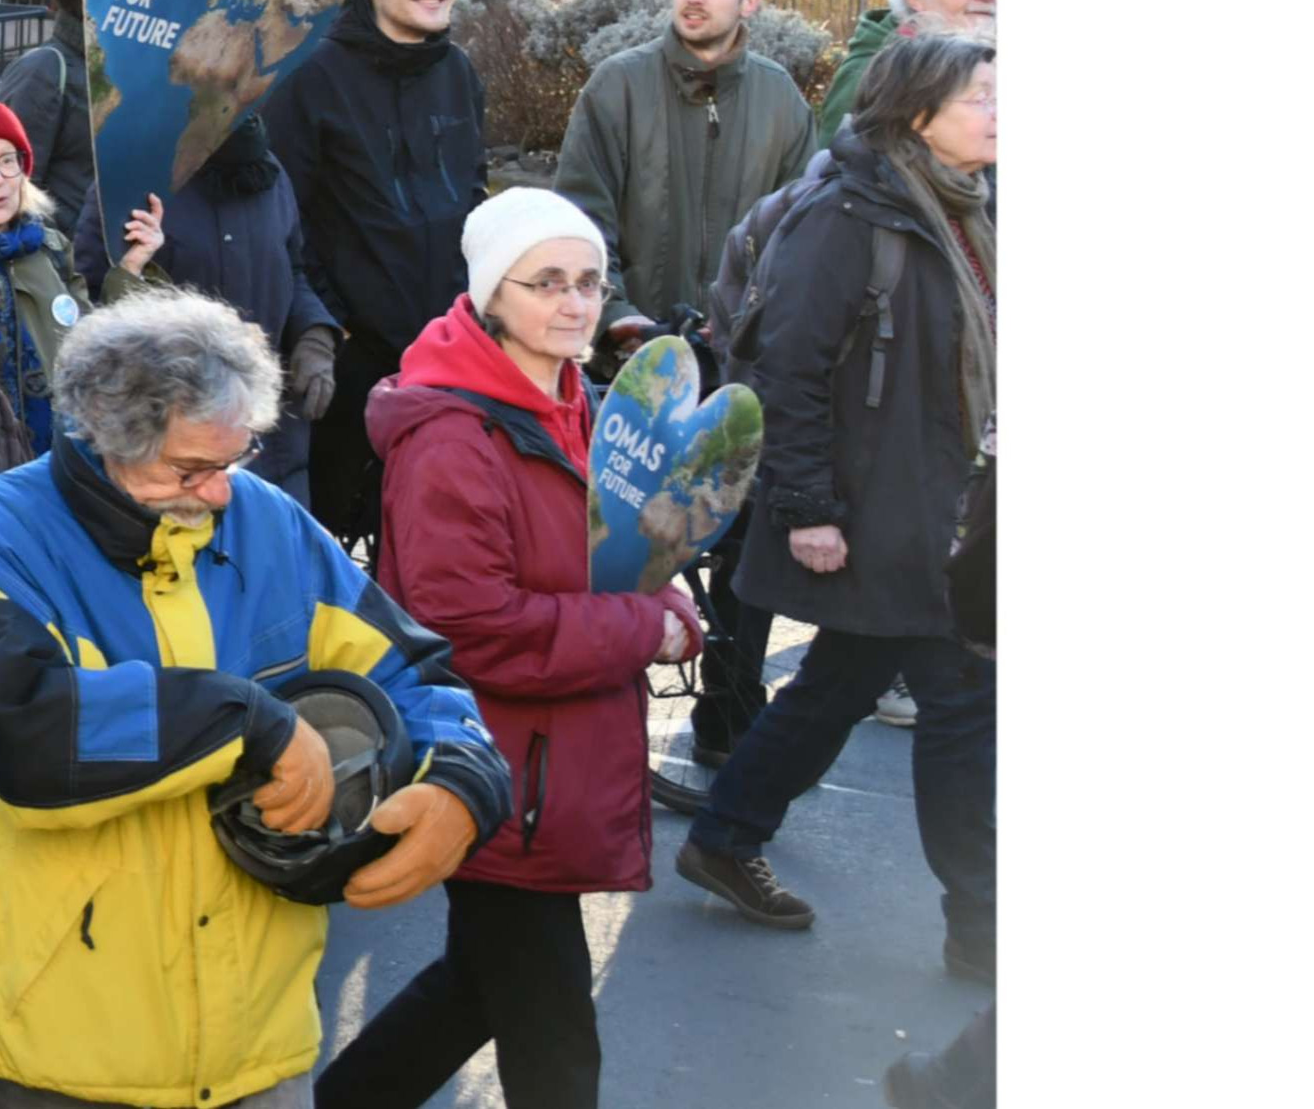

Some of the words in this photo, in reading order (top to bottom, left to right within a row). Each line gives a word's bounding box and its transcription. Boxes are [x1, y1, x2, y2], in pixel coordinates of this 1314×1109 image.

[100, 4, 182, 50] FUTURE
[604, 413, 665, 471] OMAS
[607, 450, 632, 477] FOR
[599, 467, 646, 509] FUTURE
